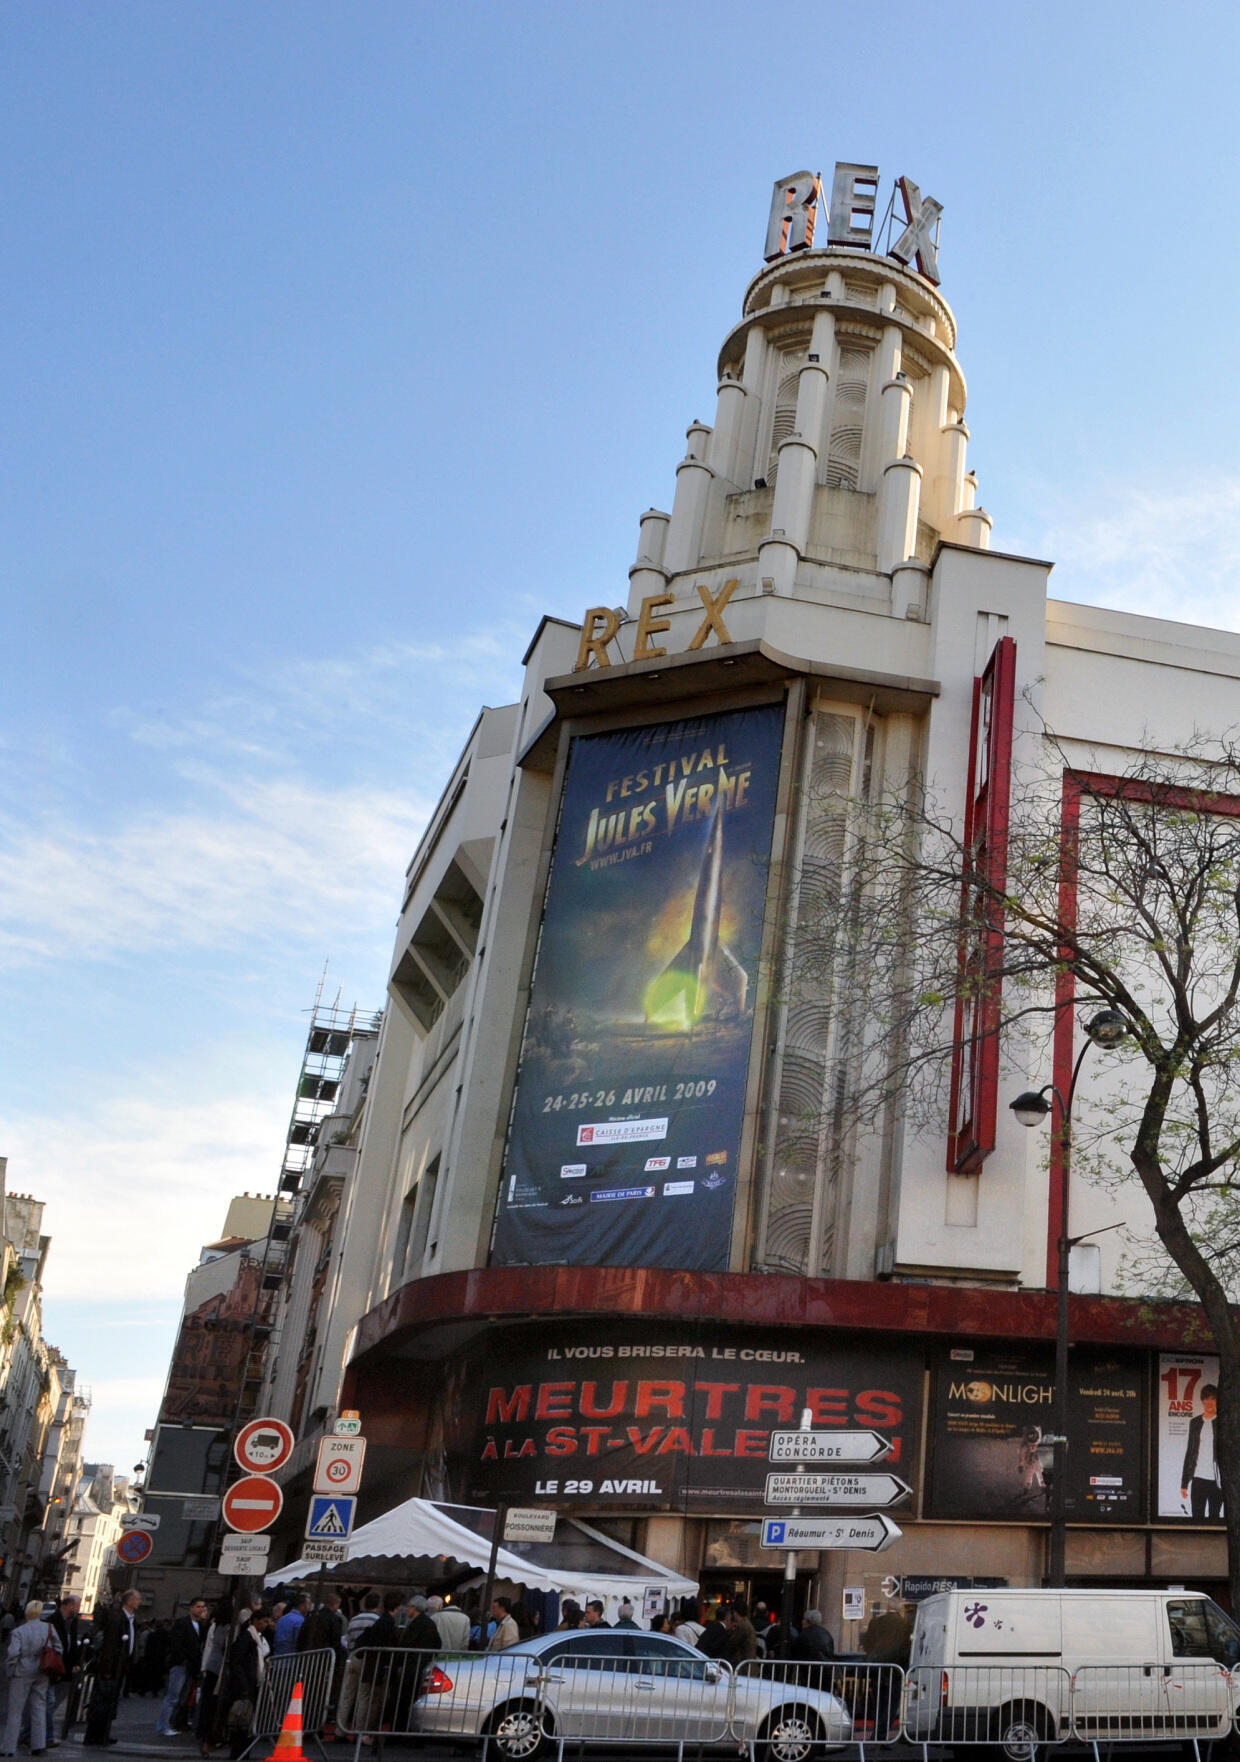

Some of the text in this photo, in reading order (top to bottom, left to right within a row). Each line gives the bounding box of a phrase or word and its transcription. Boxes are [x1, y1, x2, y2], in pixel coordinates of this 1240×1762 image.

[764, 161, 943, 286] REX
[574, 578, 739, 672] REX
[605, 743, 729, 803] FESTIVAL
[575, 770, 751, 867] JULES VERNE
[622, 1084, 667, 1105] AVRIL
[674, 1079, 717, 1100] 2009
[547, 1348, 562, 1360] IL
[564, 1347, 614, 1359] VOUS
[618, 1345, 704, 1358] BRISERA
[712, 1348, 736, 1360] LE
[1161, 1367, 1202, 1401] 17
[485, 1380, 904, 1427] MEURTRES
[1169, 1401, 1193, 1411] ANS
[330, 1442, 355, 1452] ZONE
[481, 1437, 499, 1460] À
[503, 1440, 535, 1458] LA
[777, 1436, 817, 1446] OPÉRA
[776, 1447, 842, 1457] CONCORDE
[331, 1465, 346, 1476] 30
[534, 1480, 663, 1495] LE 29 AVRIL
[773, 1476, 859, 1486] QUARTIER PIÉTONS
[772, 1486, 826, 1495] MONTORGUEIL
[843, 1486, 867, 1495] DENIS
[788, 1528, 826, 1538] Réaumur
[849, 1528, 875, 1538] Denis
[305, 1543, 345, 1553] PASSAGE
